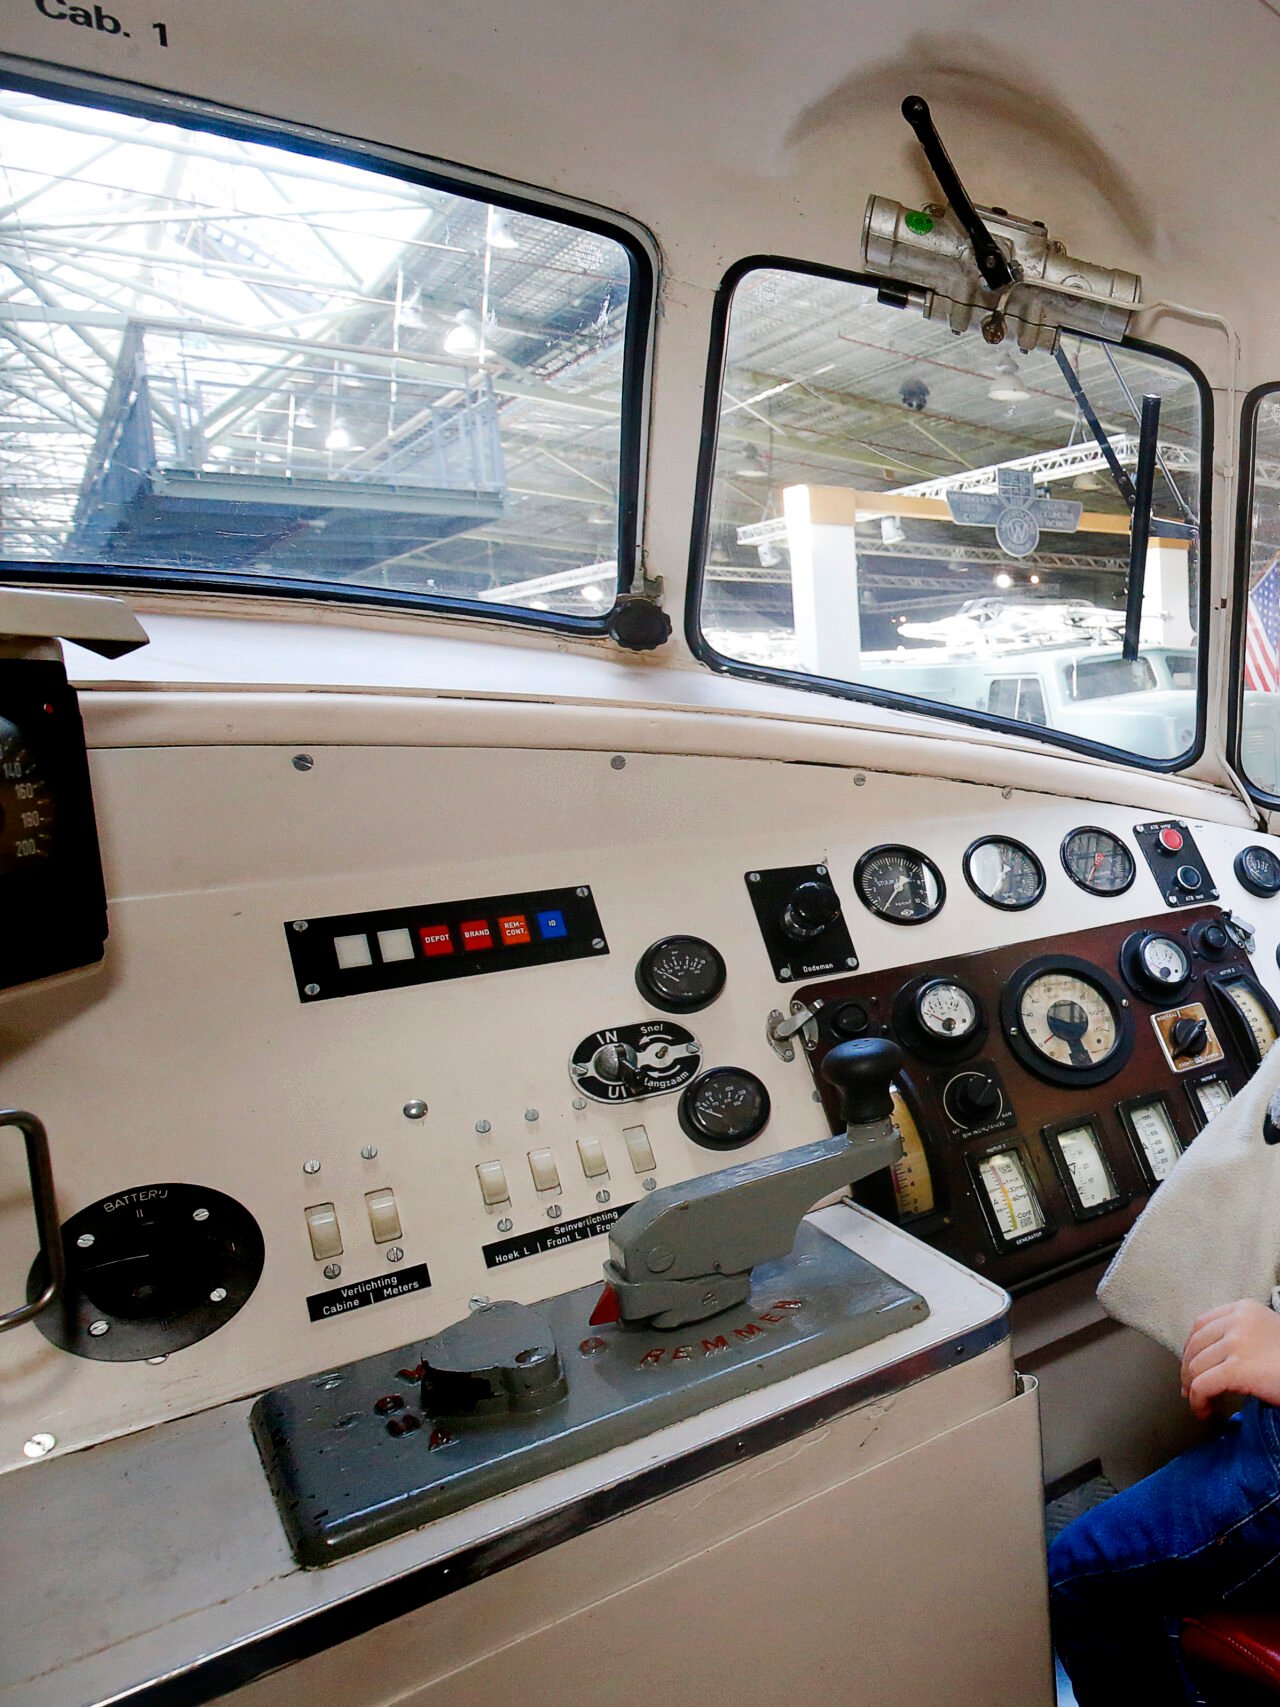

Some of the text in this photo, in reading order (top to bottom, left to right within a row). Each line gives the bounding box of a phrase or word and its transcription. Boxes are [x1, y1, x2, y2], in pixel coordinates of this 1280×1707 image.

[34, 0, 169, 48] Cab. 1
[15, 782, 34, 800] 160
[15, 839, 36, 857] 200
[464, 928, 490, 938] BRAND
[504, 921, 525, 929] REM-
[505, 928, 528, 937] CONT.
[424, 933, 450, 944] DEPOT
[596, 1030, 618, 1045] IN
[640, 1023, 664, 1034] Snel
[643, 1071, 690, 1089] Langzaam
[608, 1085, 629, 1099] UI
[553, 1210, 619, 1236] Seinverlichting
[495, 1220, 618, 1264] Hoek L Front L Fron
[340, 1276, 398, 1298] Verlichting
[322, 1281, 420, 1316] Cabine Meters
[638, 1299, 802, 1368] REMMEN
